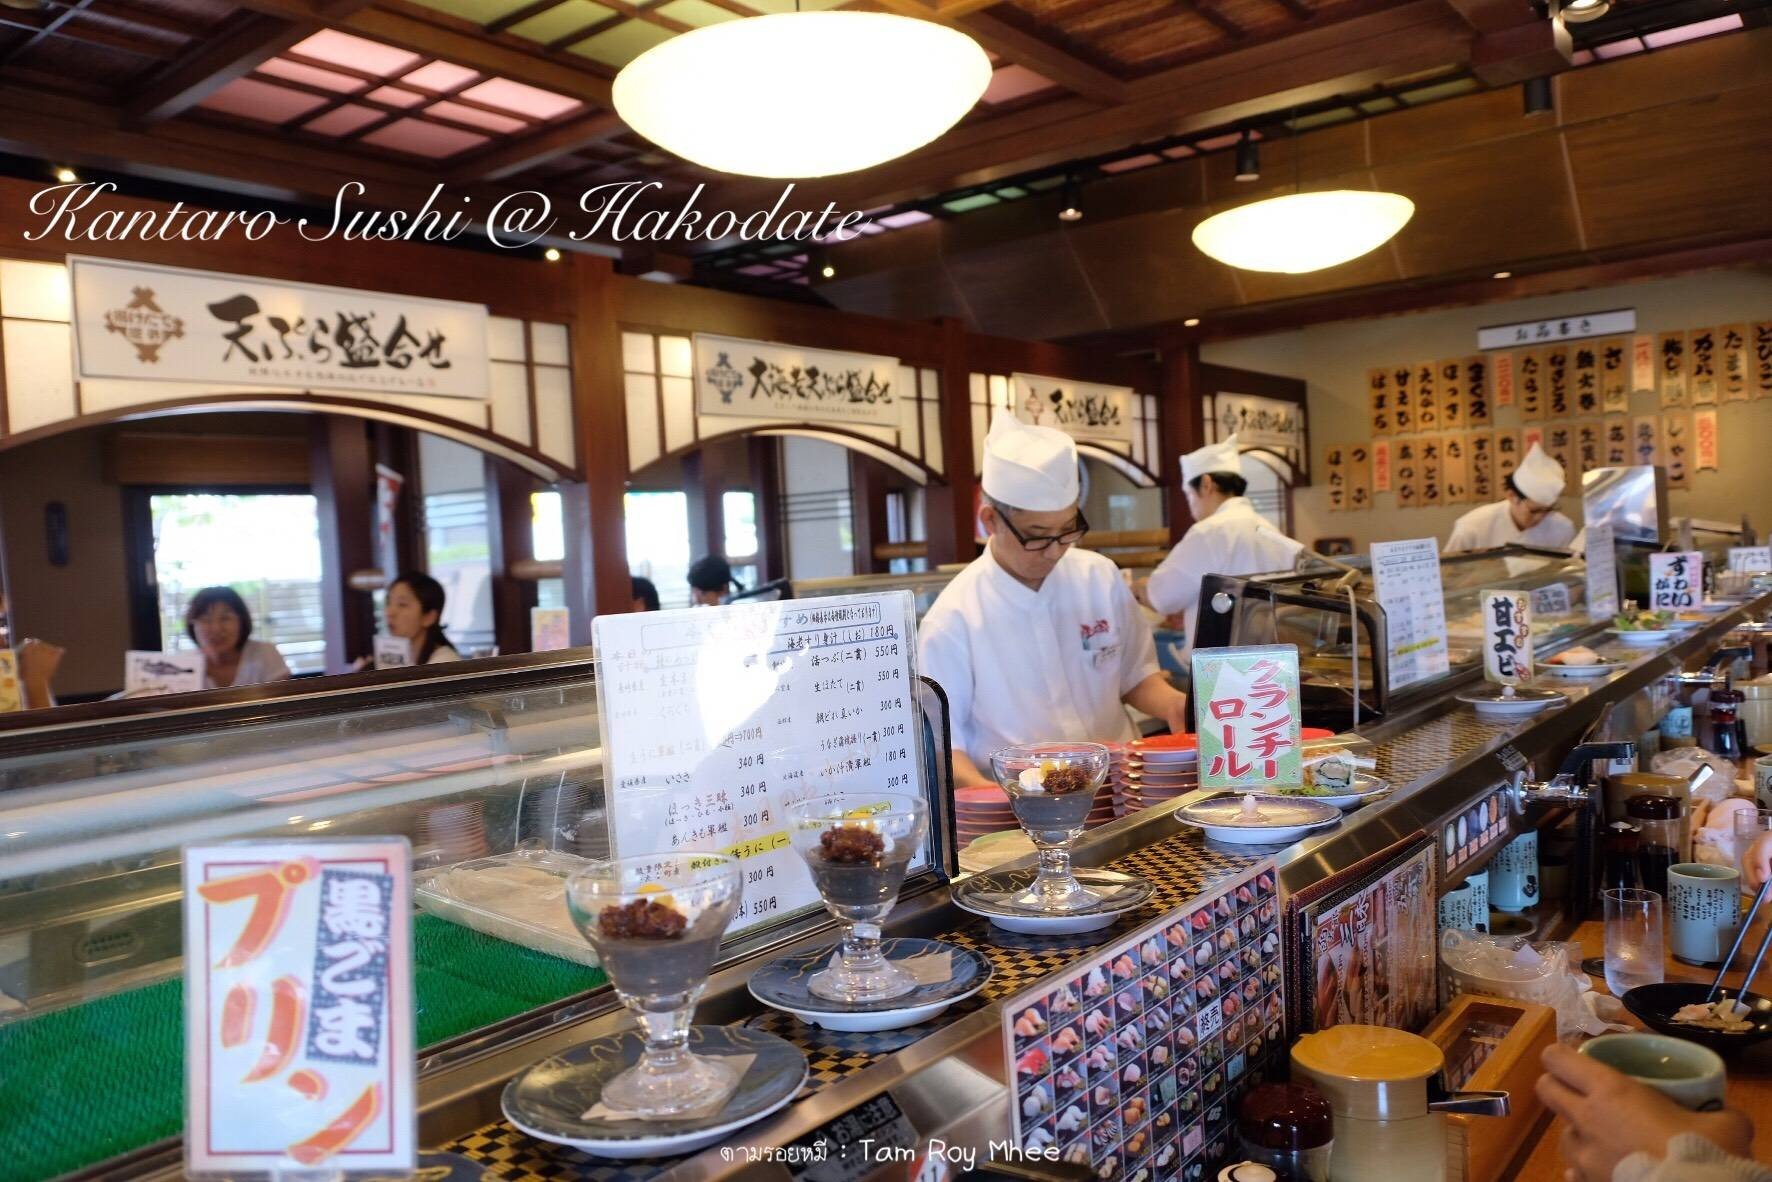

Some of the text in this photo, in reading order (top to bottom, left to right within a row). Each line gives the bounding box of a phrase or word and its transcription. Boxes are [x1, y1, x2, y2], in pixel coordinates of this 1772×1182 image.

[207, 294, 452, 369] 天ぷら盛合せ
[870, 624, 894, 640] 180円
[1491, 596, 1516, 676] 甘エビ
[875, 643, 898, 658] 550円
[878, 668, 899, 682] 550円
[880, 697, 902, 711] 300円
[1246, 658, 1294, 780] クランチー
[883, 723, 904, 738] 300円
[1207, 697, 1254, 779] ロール
[738, 752, 764, 770] 340円
[885, 748, 906, 763] 180円
[740, 780, 767, 798] 340円
[887, 773, 908, 788] 300円
[743, 809, 769, 827] 300円
[748, 865, 775, 884] 300円
[753, 895, 777, 915] 550円
[196, 856, 384, 1166] プリン
